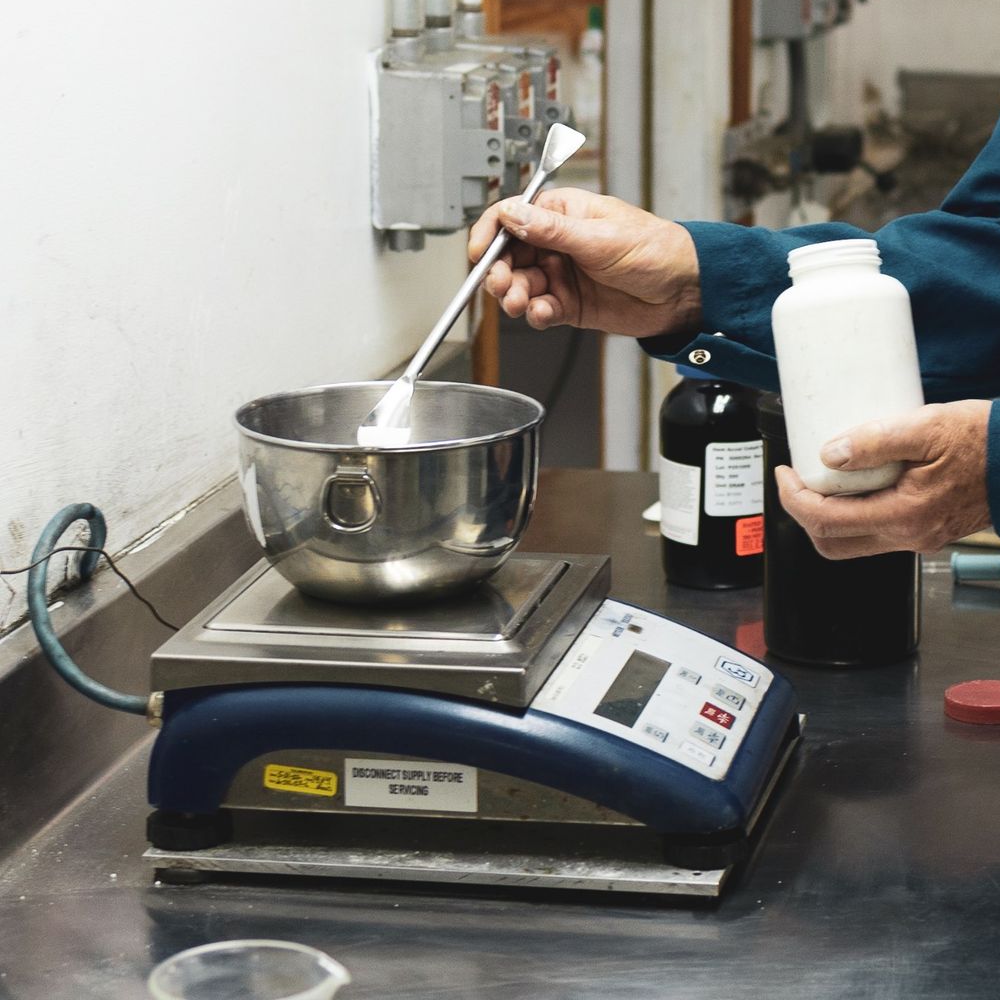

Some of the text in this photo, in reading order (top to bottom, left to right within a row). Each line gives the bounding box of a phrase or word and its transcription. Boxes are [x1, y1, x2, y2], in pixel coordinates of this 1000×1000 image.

[352, 767, 463, 783] DISCONNECT SUPPLY BEFORE
[389, 784, 429, 796] SERVICING
